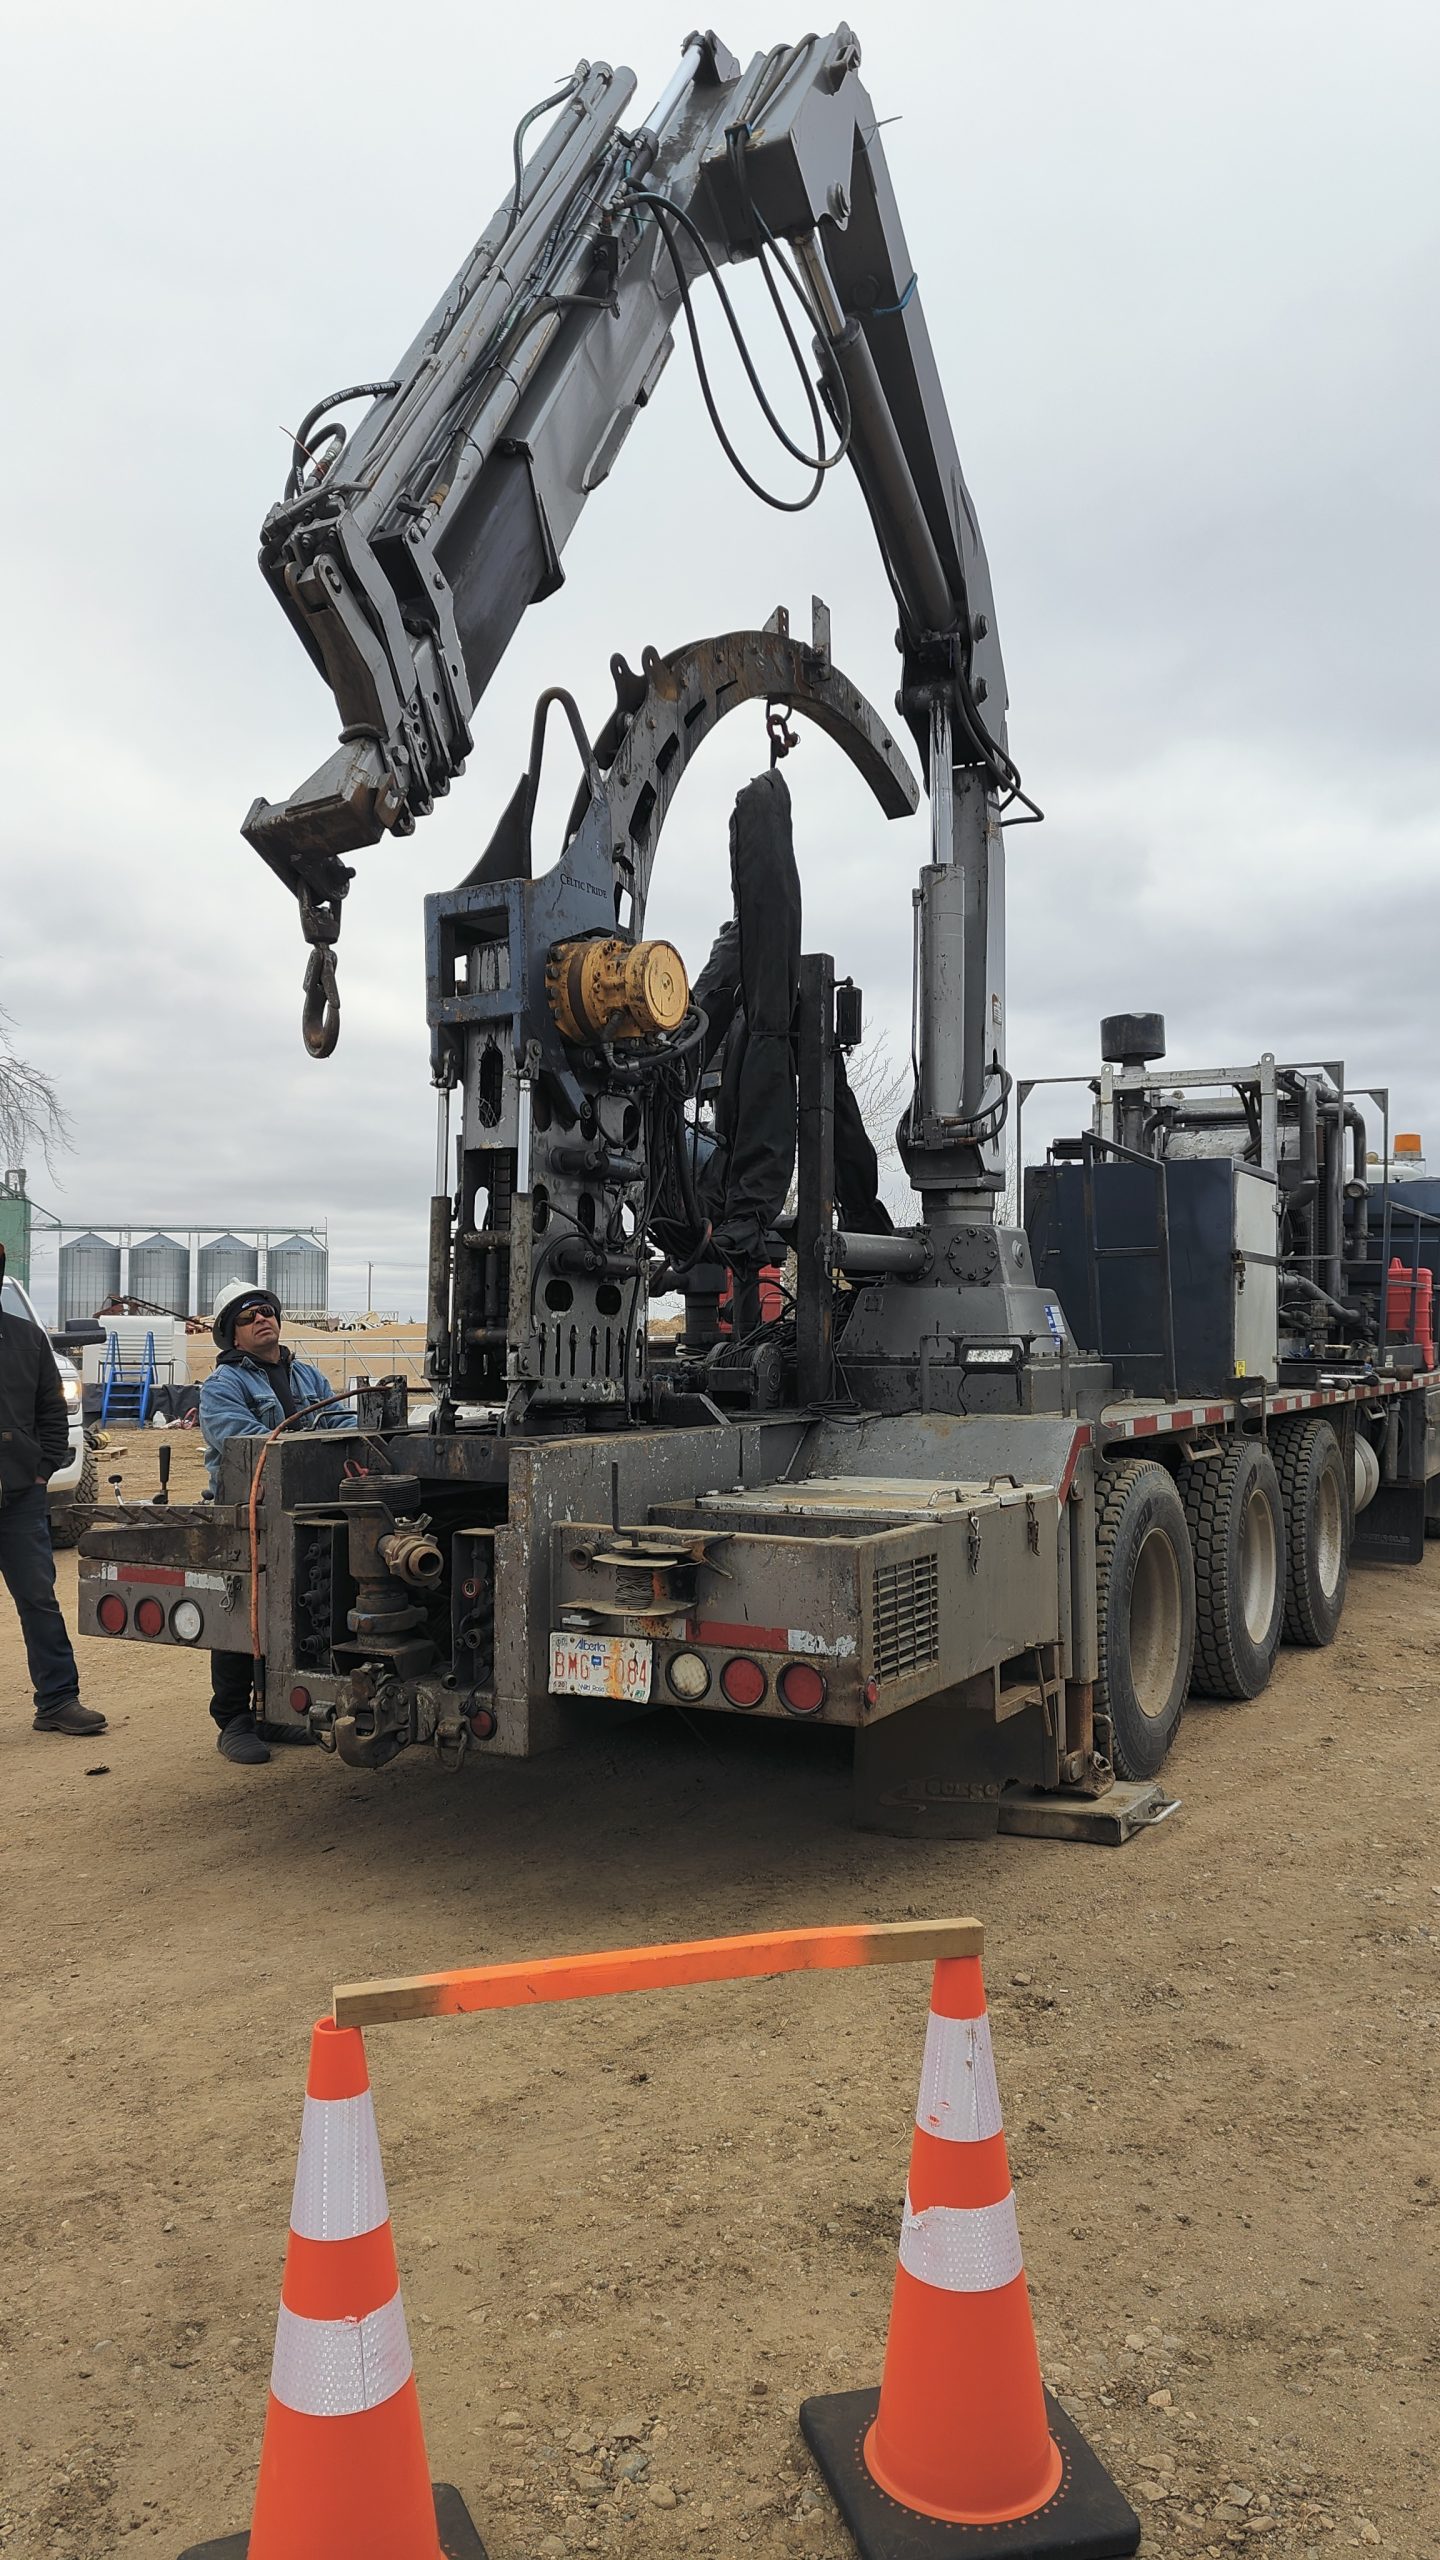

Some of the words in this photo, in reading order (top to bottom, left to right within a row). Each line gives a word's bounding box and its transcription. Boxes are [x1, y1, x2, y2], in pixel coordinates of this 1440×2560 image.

[560, 873, 586, 891] CELTIC
[586, 882, 607, 898] PRIDE
[574, 1637, 606, 1653] Alberta
[554, 1651, 590, 1680] BMG
[603, 1655, 647, 1688] 5084
[579, 1683, 591, 1692] Wild
